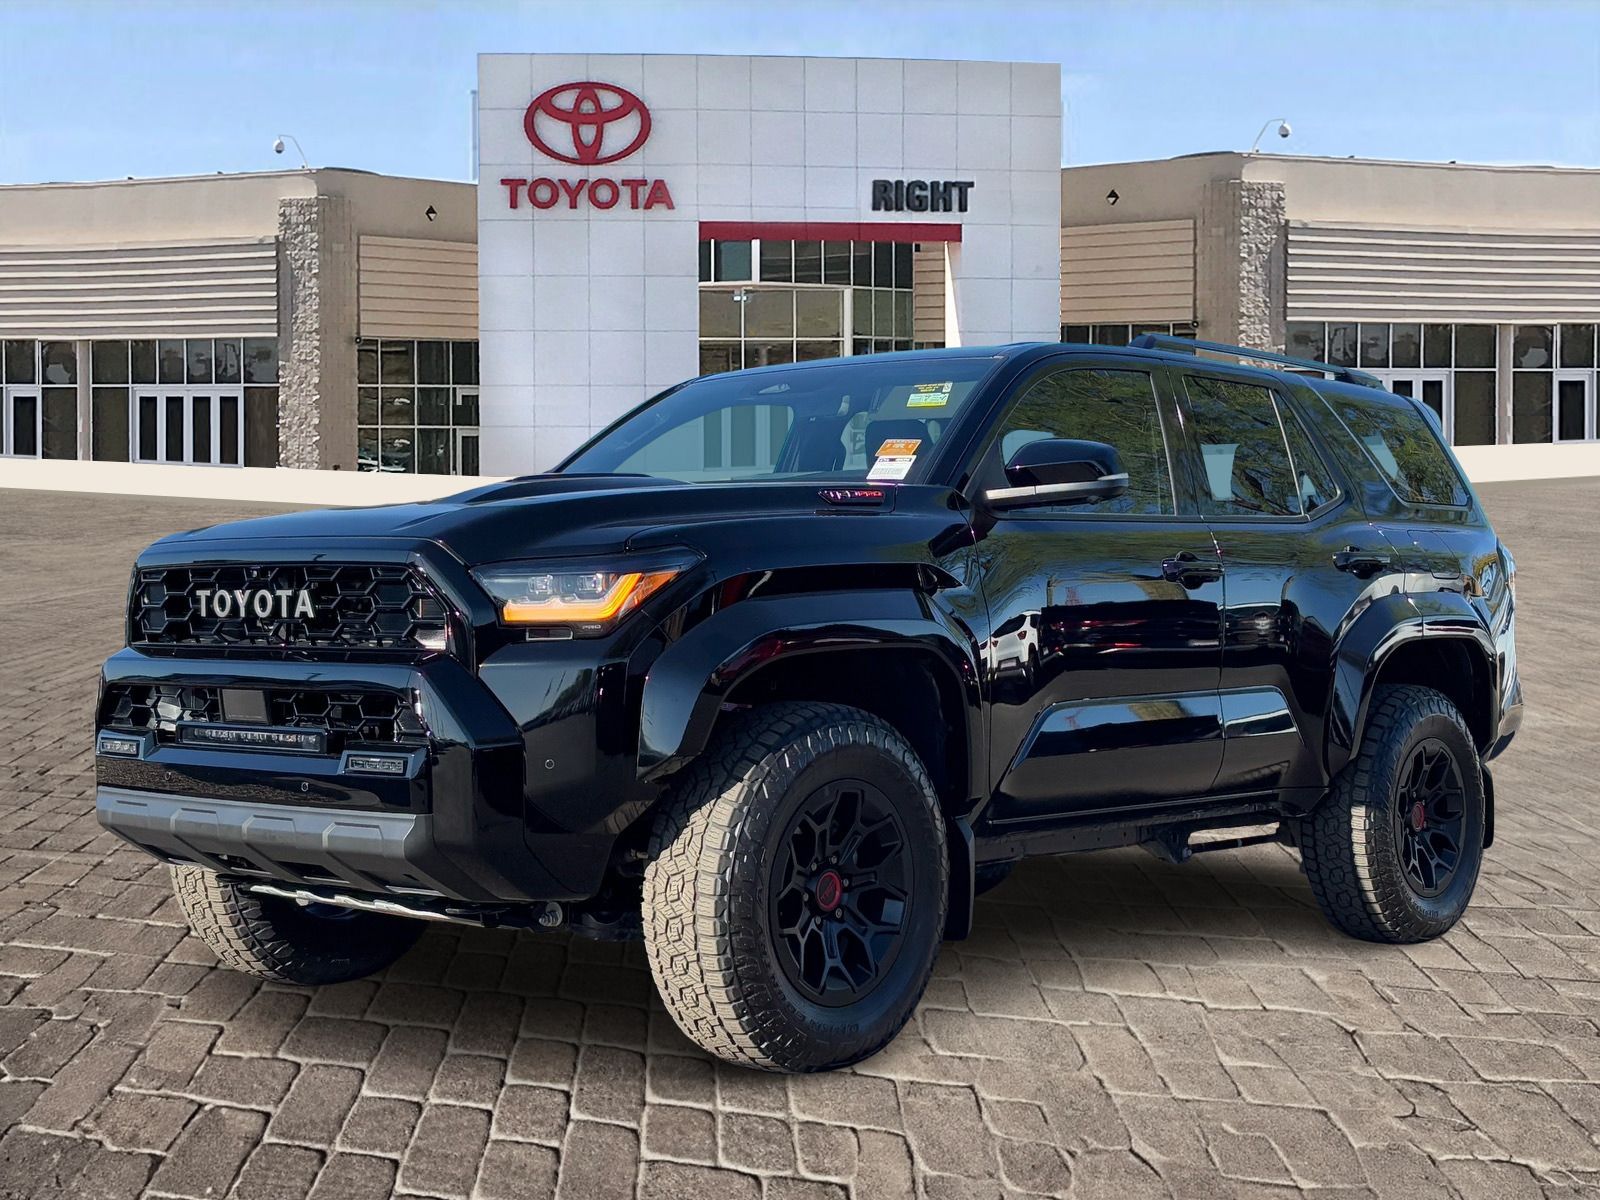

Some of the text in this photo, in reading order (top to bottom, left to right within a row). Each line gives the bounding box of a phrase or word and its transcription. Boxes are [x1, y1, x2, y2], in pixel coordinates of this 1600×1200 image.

[500, 177, 675, 210] TOYOTA
[872, 179, 975, 212] RIGHT
[195, 589, 314, 618] TOYOTA
